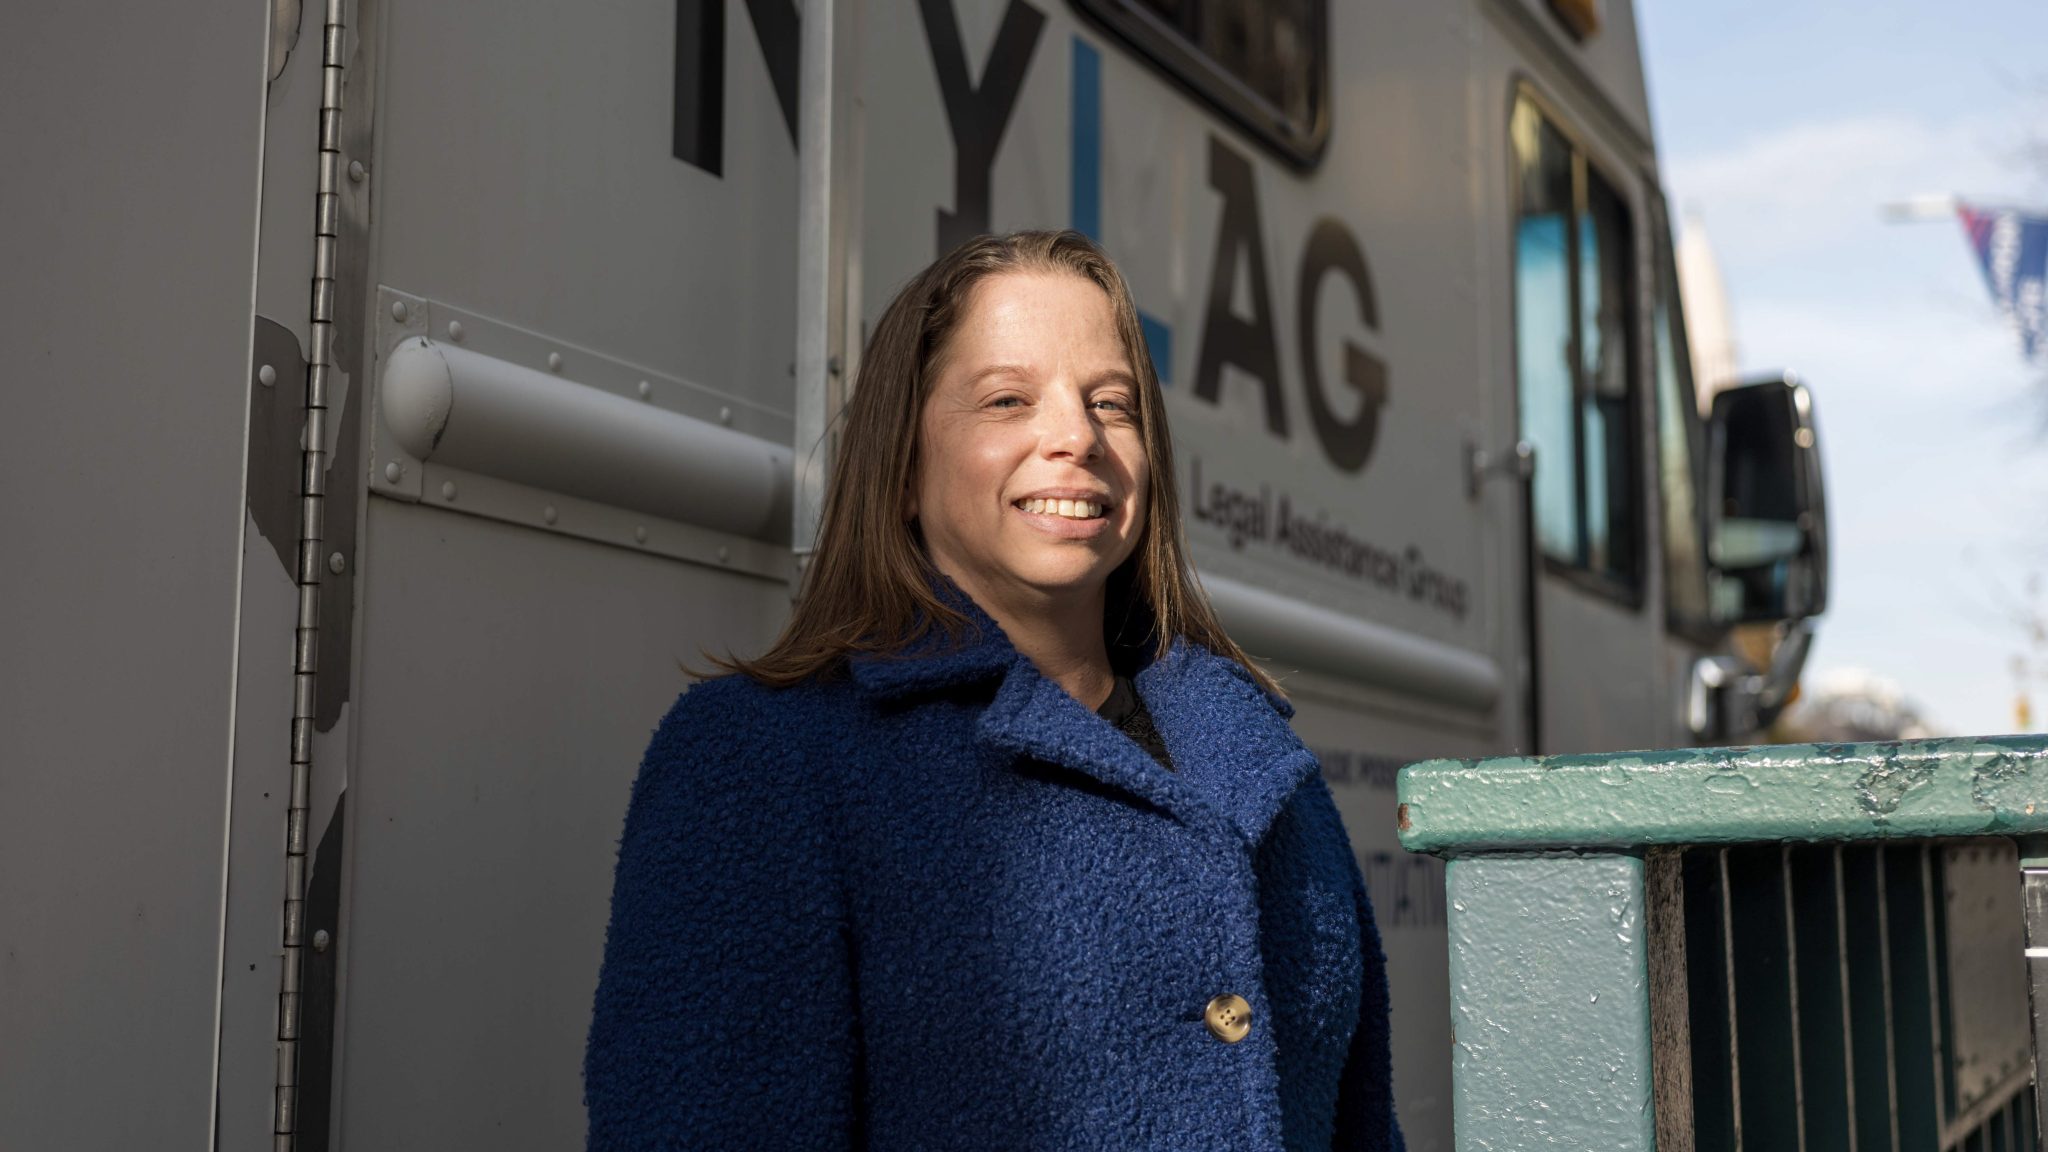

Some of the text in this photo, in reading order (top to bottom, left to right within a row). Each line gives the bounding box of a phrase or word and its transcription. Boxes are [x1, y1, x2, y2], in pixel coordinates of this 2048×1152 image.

[1191, 457, 1470, 620] Legal Assistance Group
